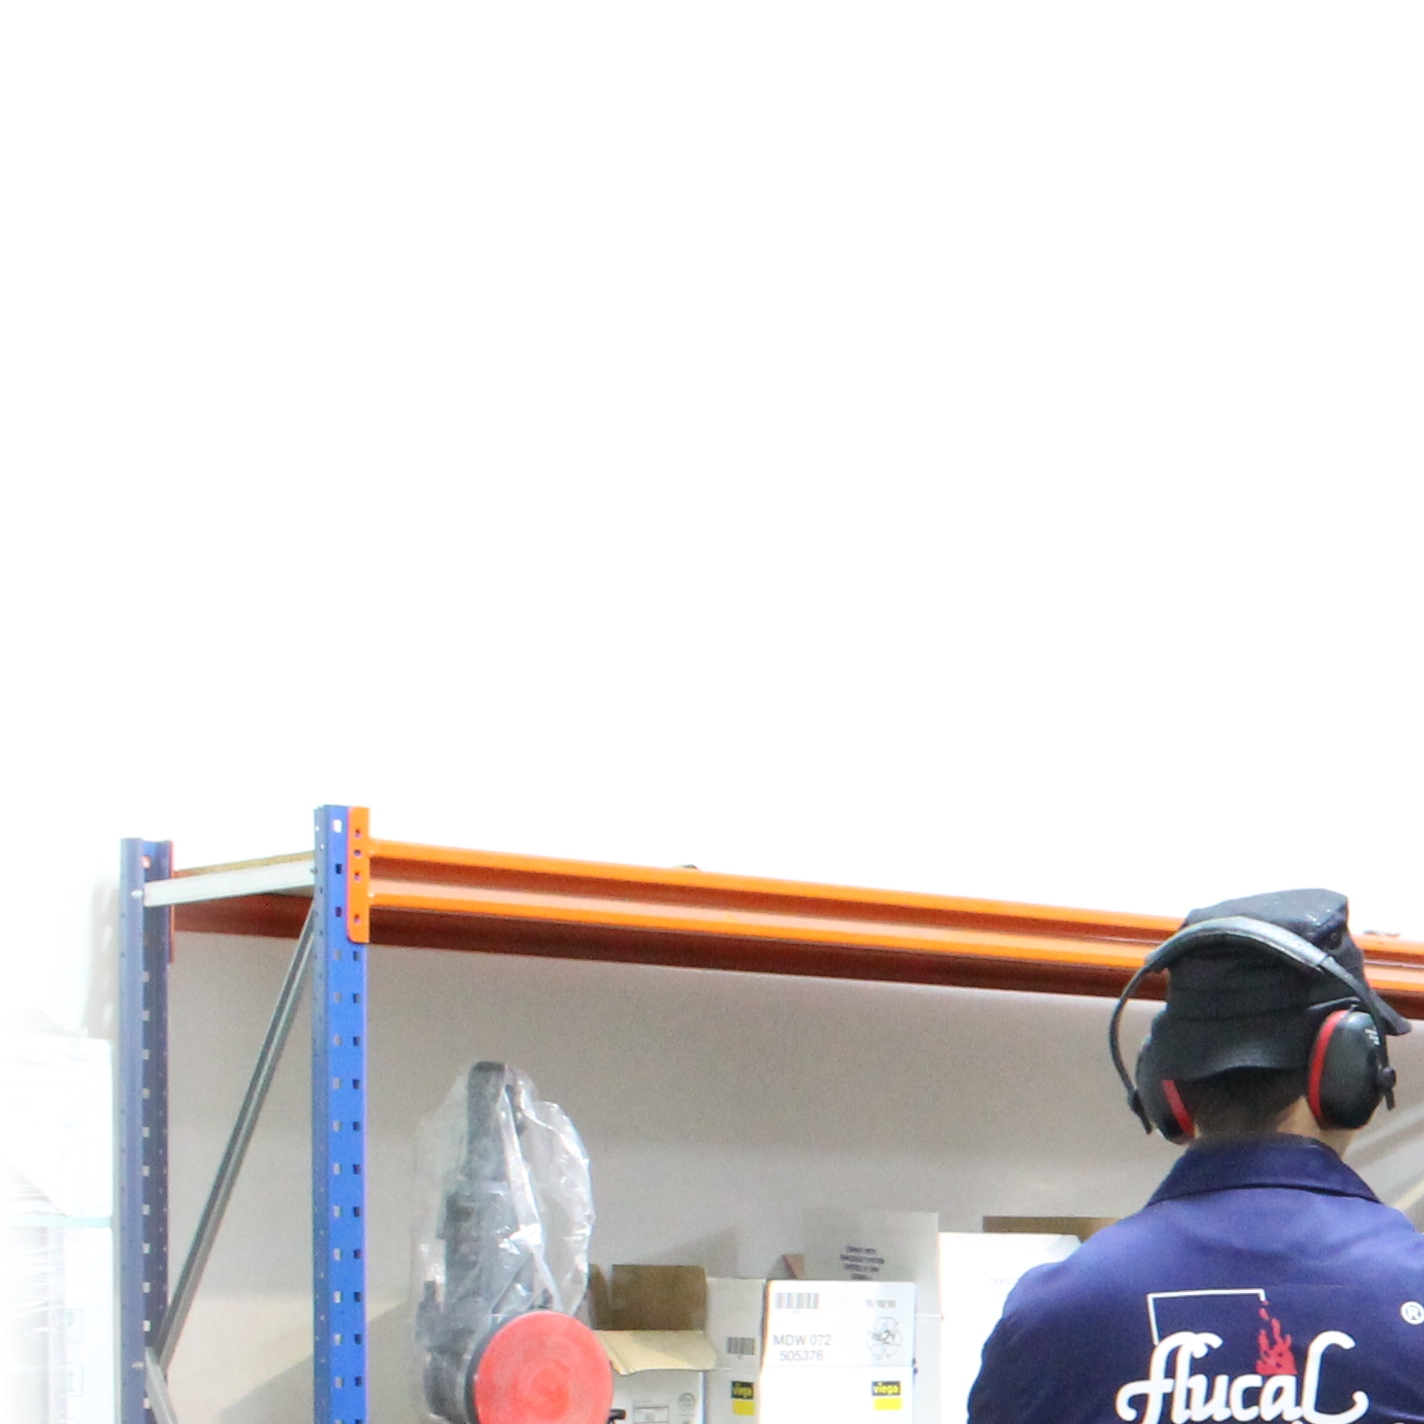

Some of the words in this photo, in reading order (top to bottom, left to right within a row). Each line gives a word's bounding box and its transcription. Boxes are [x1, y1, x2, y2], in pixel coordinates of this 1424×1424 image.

[773, 1334, 807, 1346] MDW
[810, 1334, 832, 1346] 072
[779, 1350, 824, 1362] 505376
[873, 1381, 900, 1395] viega
